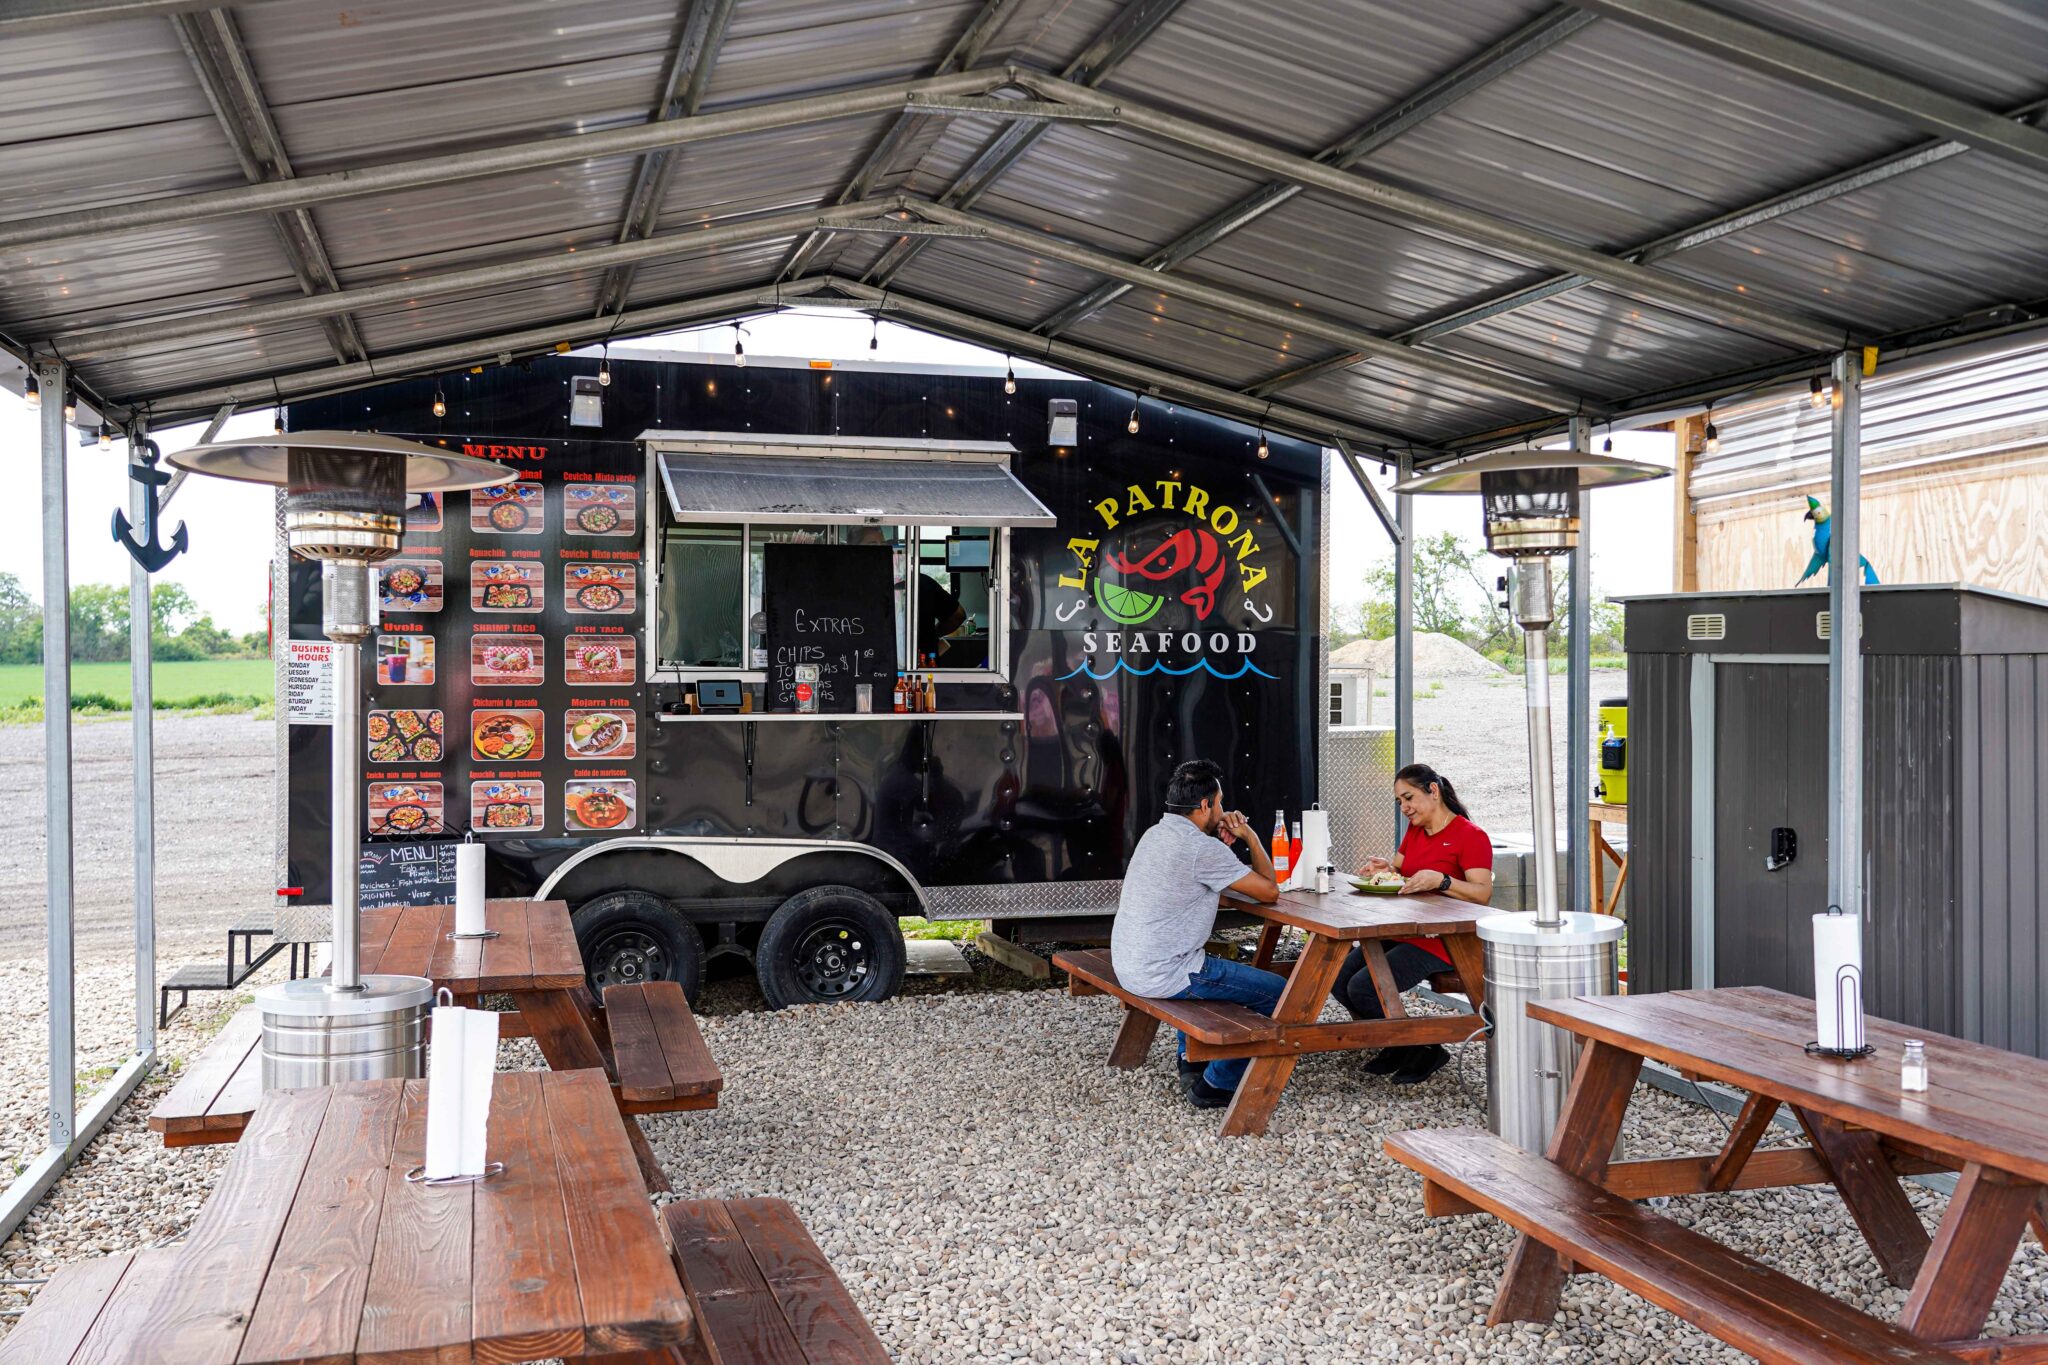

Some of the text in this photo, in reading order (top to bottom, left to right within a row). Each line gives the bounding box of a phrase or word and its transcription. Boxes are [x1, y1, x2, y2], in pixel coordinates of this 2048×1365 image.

[462, 444, 548, 460] MENU
[519, 470, 543, 480] ginal
[563, 471, 637, 483] Ceviche Mixto verde
[1058, 480, 1268, 594] LA PATRONA
[469, 548, 541, 559] Aguachile original
[560, 549, 640, 560] Ceviche Mixto original
[384, 623, 424, 632] Uvola
[473, 623, 536, 633] SHRIMP TACO
[1083, 632, 1257, 653] SEAFOOD
[297, 653, 329, 662] HOURS
[777, 646, 825, 665] CHIPS
[505, 698, 513, 707] de
[514, 698, 538, 707] pescado
[571, 698, 630, 708] Mojarra Frita
[574, 769, 627, 777] Caldo de mariscos
[390, 845, 435, 862] MENU
[441, 873, 457, 881] Wate
[360, 880, 395, 890] eviches:
